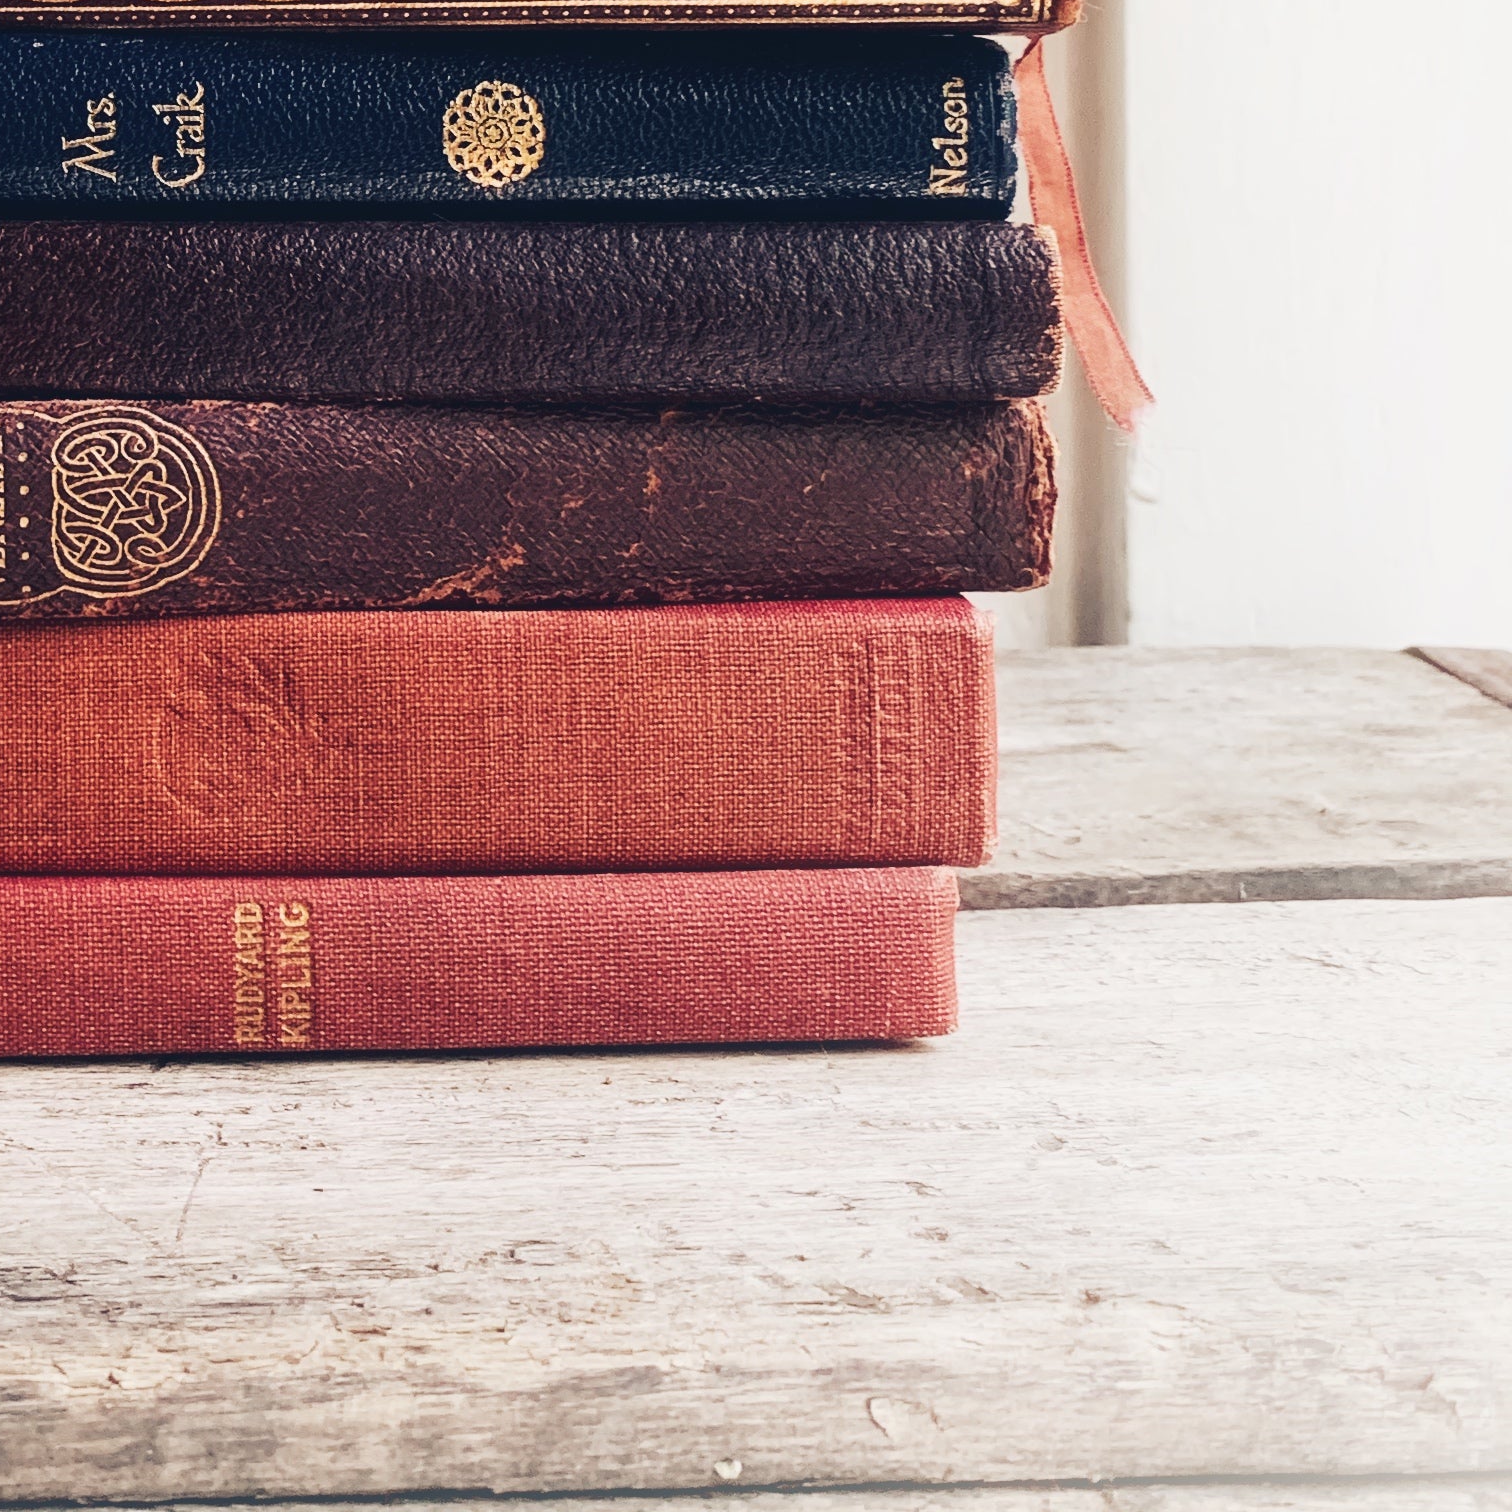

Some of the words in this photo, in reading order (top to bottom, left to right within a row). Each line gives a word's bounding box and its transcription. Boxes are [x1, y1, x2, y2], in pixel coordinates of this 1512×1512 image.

[61, 92, 117, 183] Mrs.
[152, 81, 205, 188] Craik
[928, 77, 968, 196] Nelson
[233, 901, 265, 1043] RUDYARD
[280, 901, 312, 1043] KIPLING
